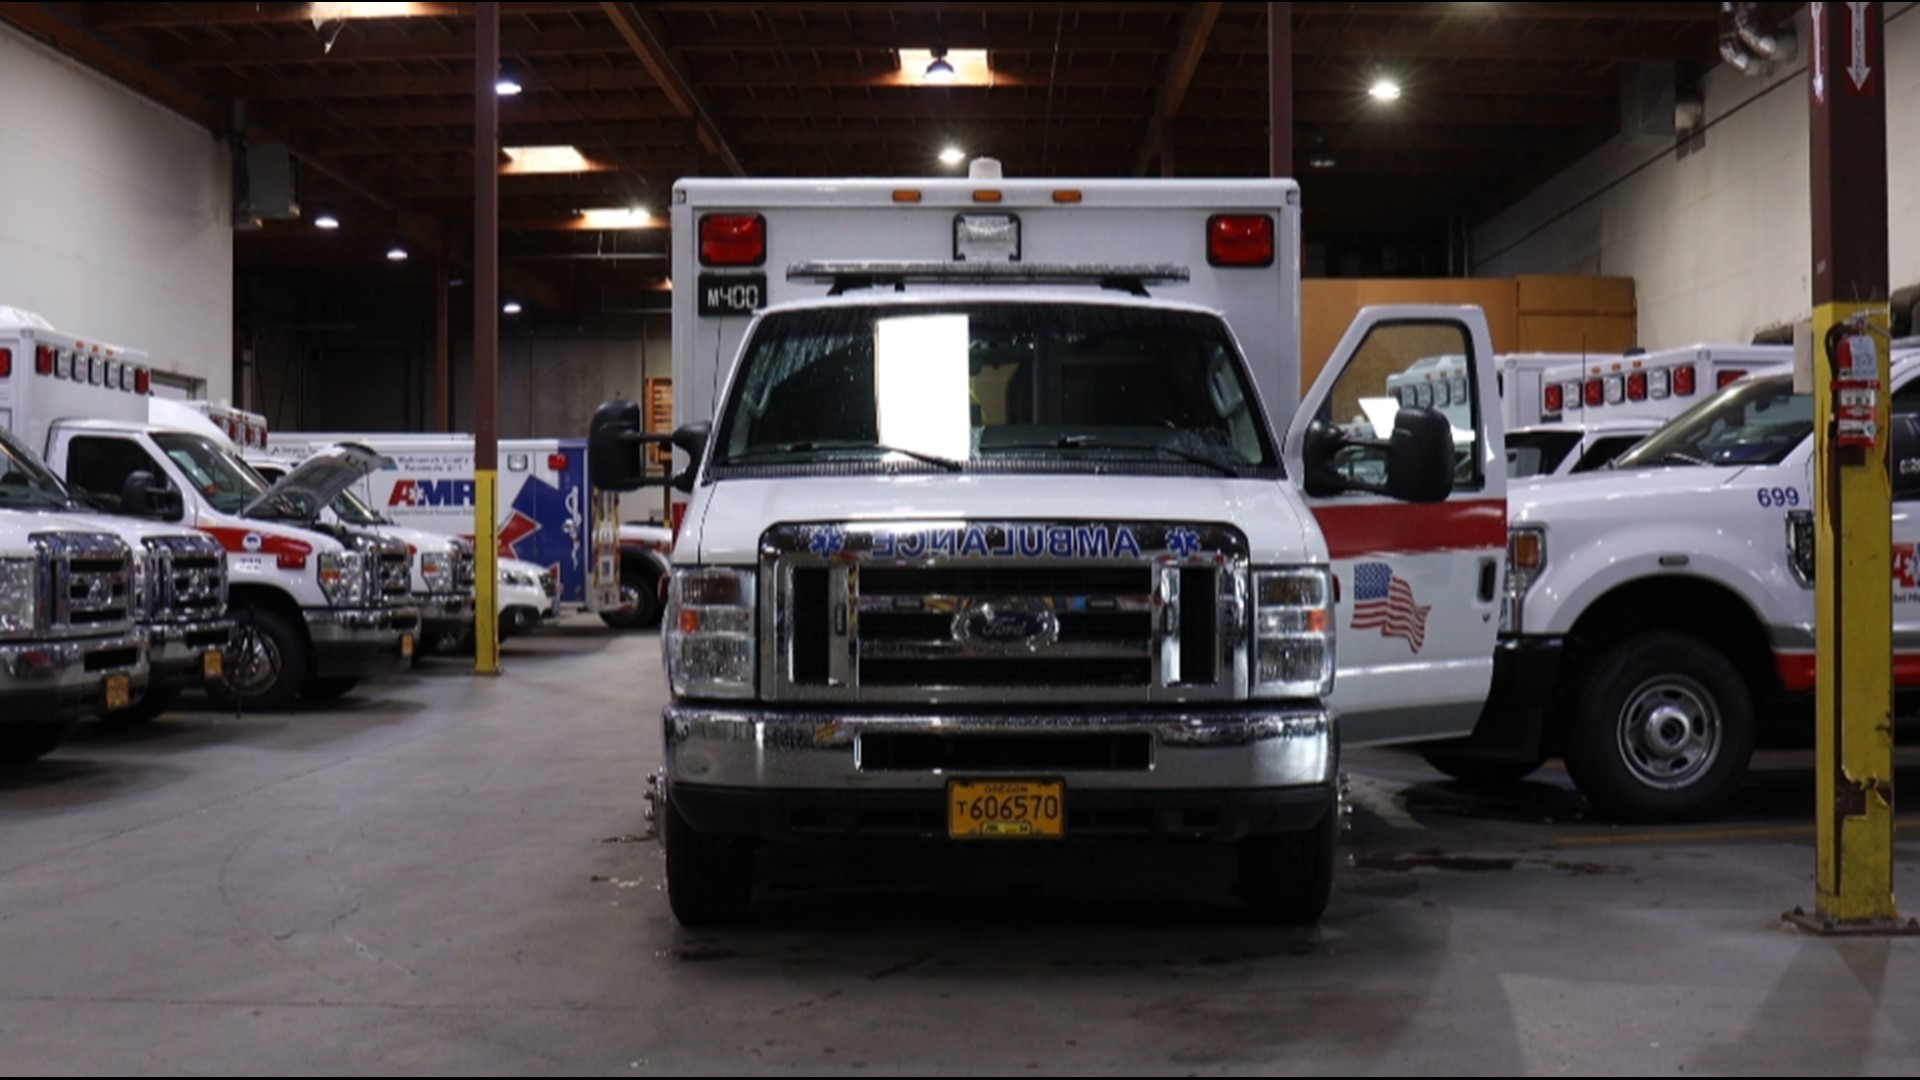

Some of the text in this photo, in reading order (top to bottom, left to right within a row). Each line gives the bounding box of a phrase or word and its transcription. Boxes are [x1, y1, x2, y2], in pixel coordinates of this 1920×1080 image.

[707, 285, 759, 309] M400
[388, 479, 476, 507] AMR
[1757, 486, 1799, 508] 699
[982, 618, 1028, 636] Ford
[956, 794, 1059, 820] T606570
